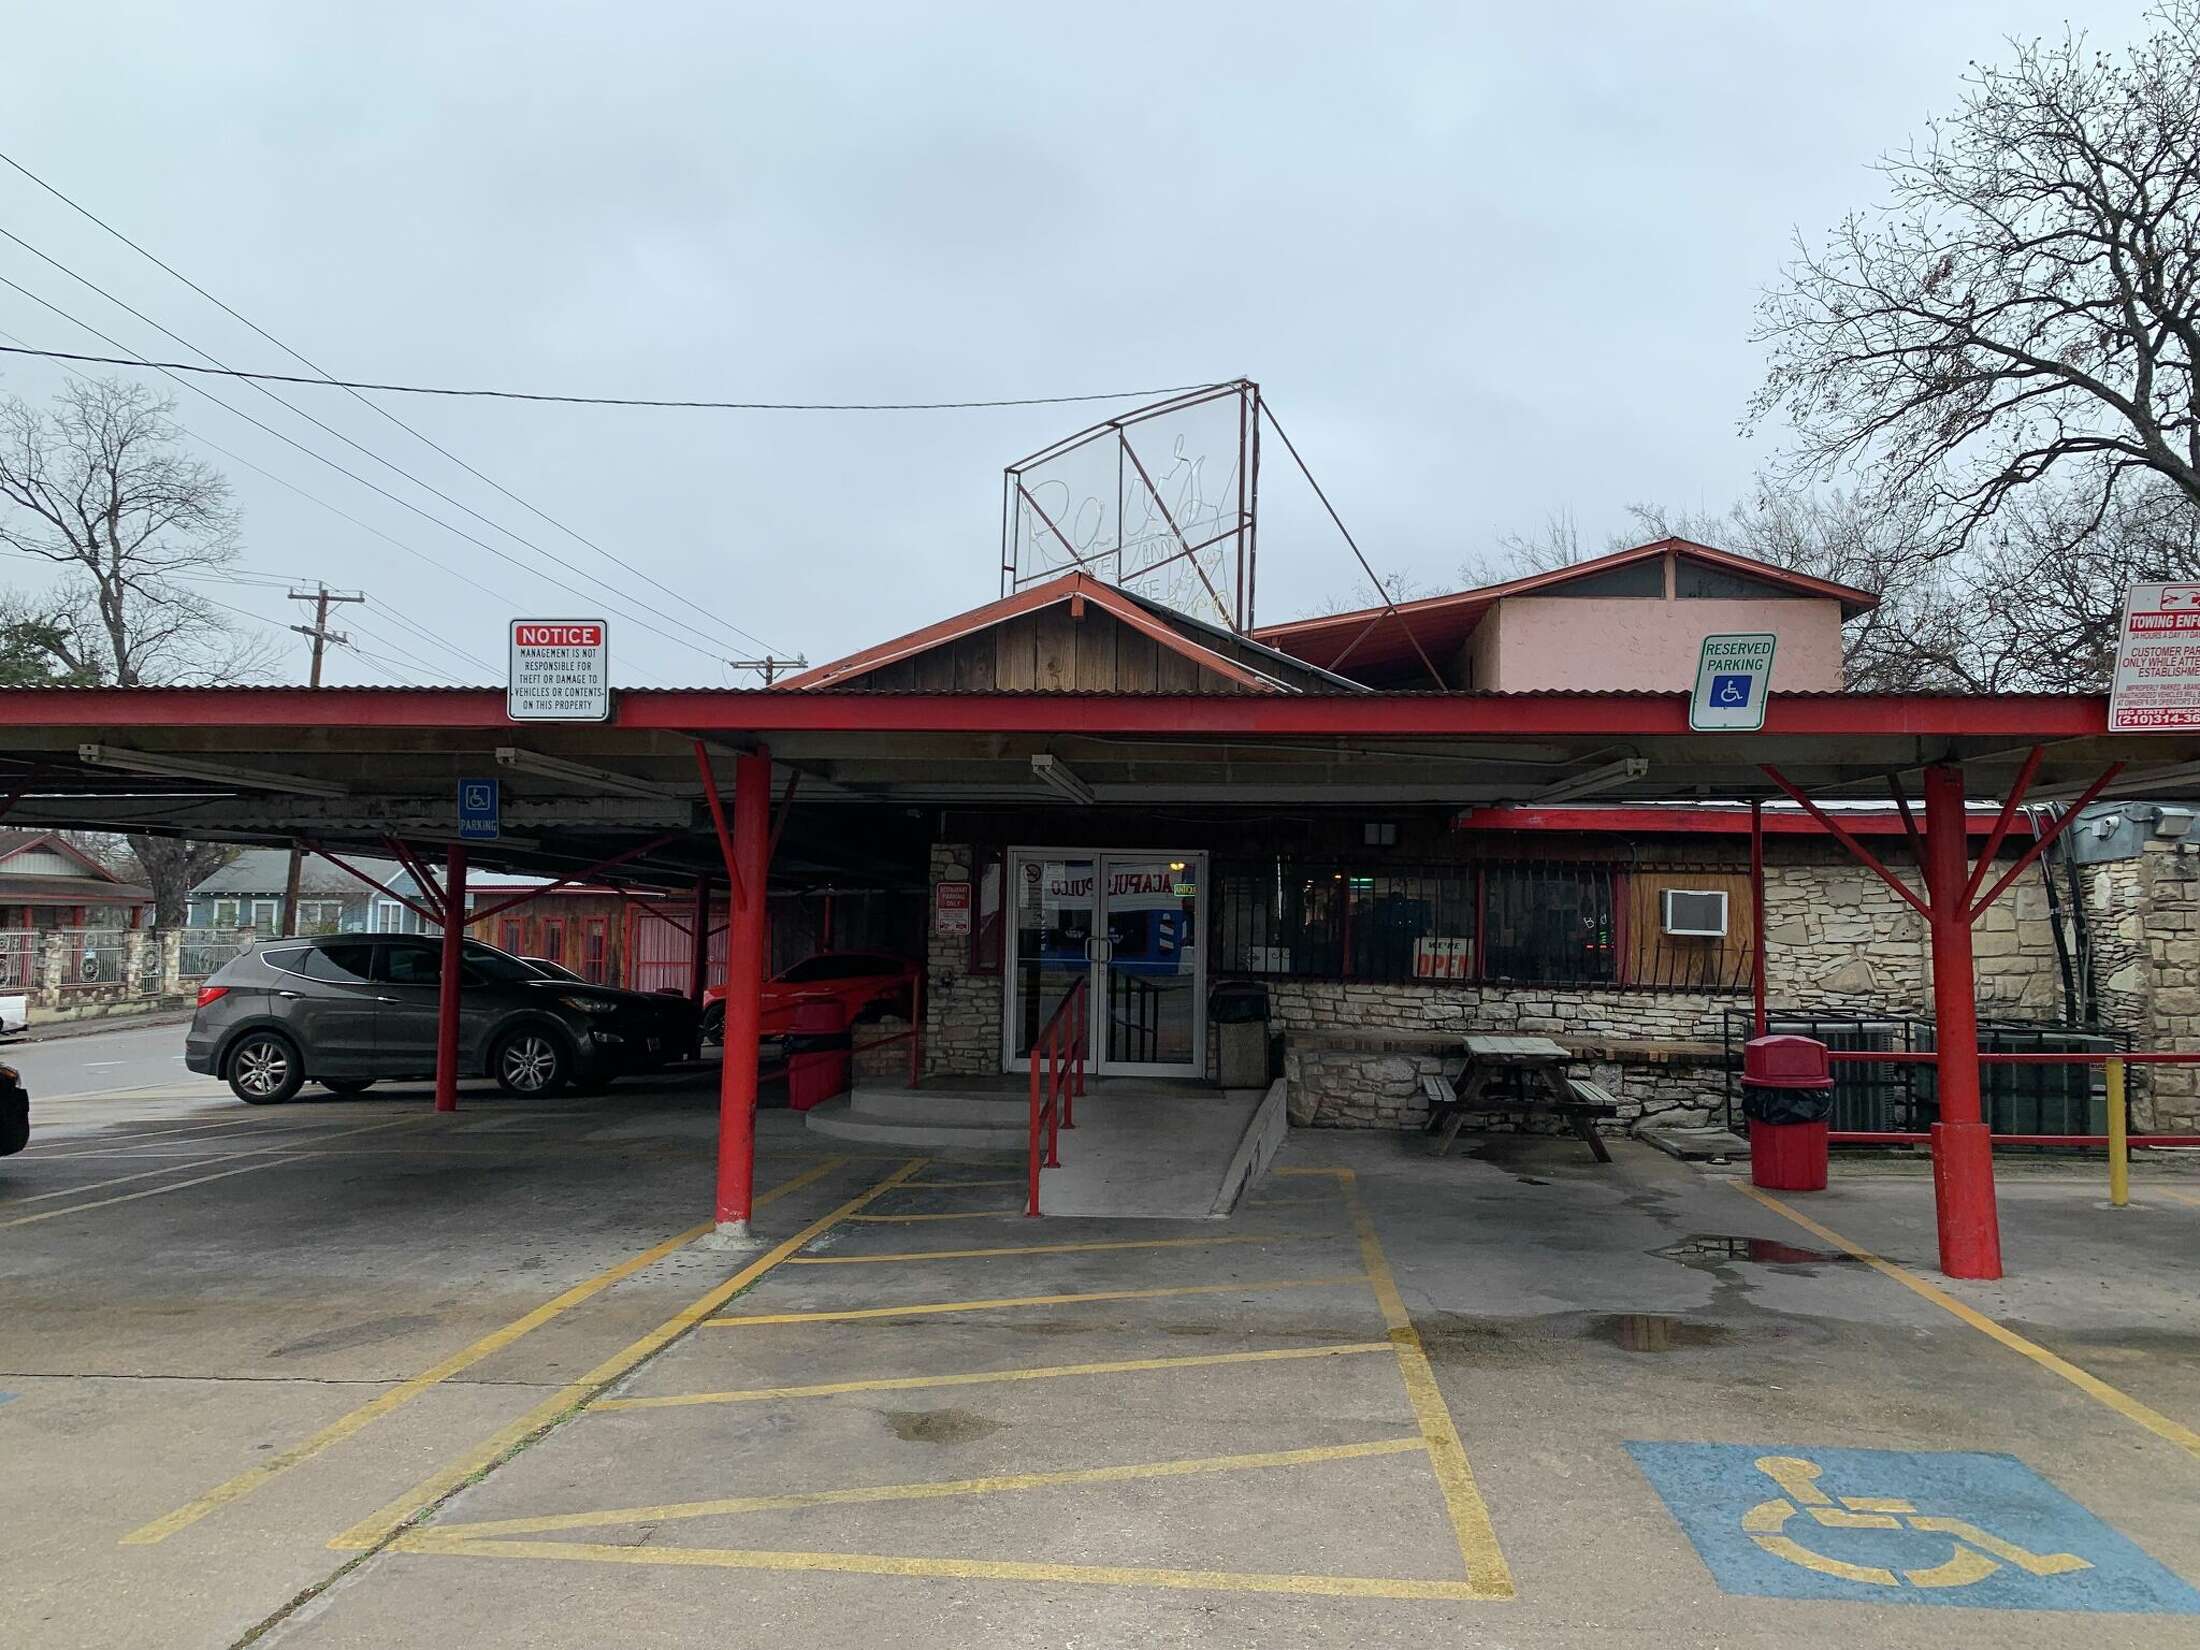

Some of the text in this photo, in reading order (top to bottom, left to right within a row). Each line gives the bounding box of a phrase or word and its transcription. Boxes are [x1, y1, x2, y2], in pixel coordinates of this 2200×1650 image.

[2131, 614, 2174, 628] TOWING
[522, 628, 595, 644] NOTICE
[520, 648, 596, 658] MANAGEMENT IS NOT
[1706, 642, 1770, 656] RESERVED
[2132, 646, 2182, 657] CUSTOMER
[524, 662, 592, 671] RESPONSIBLE FOR
[1707, 658, 1764, 671] PARKING
[2122, 658, 2146, 668] ONLY
[2148, 656, 2176, 667] WHILE
[520, 674, 598, 684] THEFT OR DAMAGE TO
[514, 688, 602, 697] VEHICLES OR CONTENTS
[522, 700, 592, 710] ON THIS PROPERTY
[460, 819, 497, 831] PARKING
